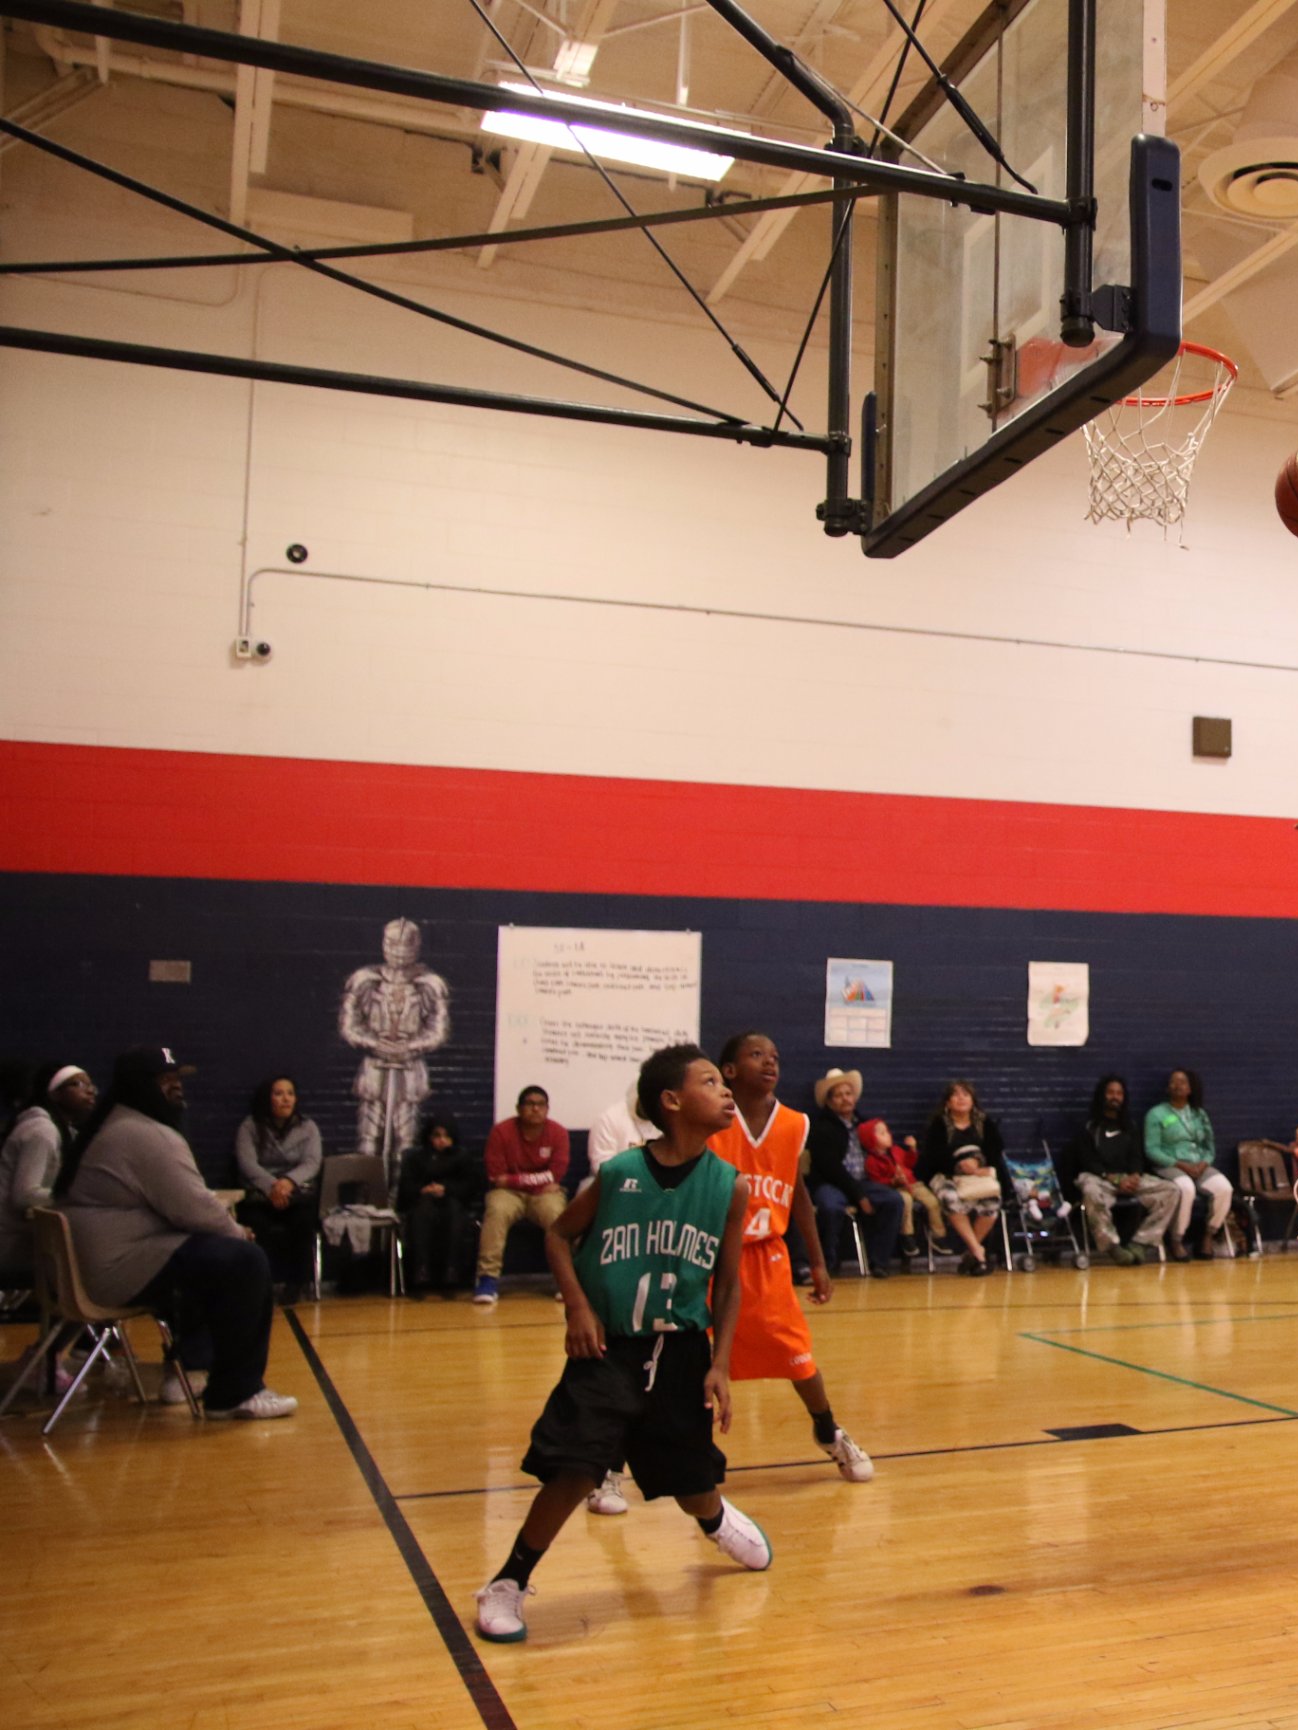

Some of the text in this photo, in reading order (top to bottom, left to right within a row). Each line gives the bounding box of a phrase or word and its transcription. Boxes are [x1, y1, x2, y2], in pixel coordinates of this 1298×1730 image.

[600, 1219, 720, 1270] ZAN HOLMES
[744, 1208, 772, 1240] 4
